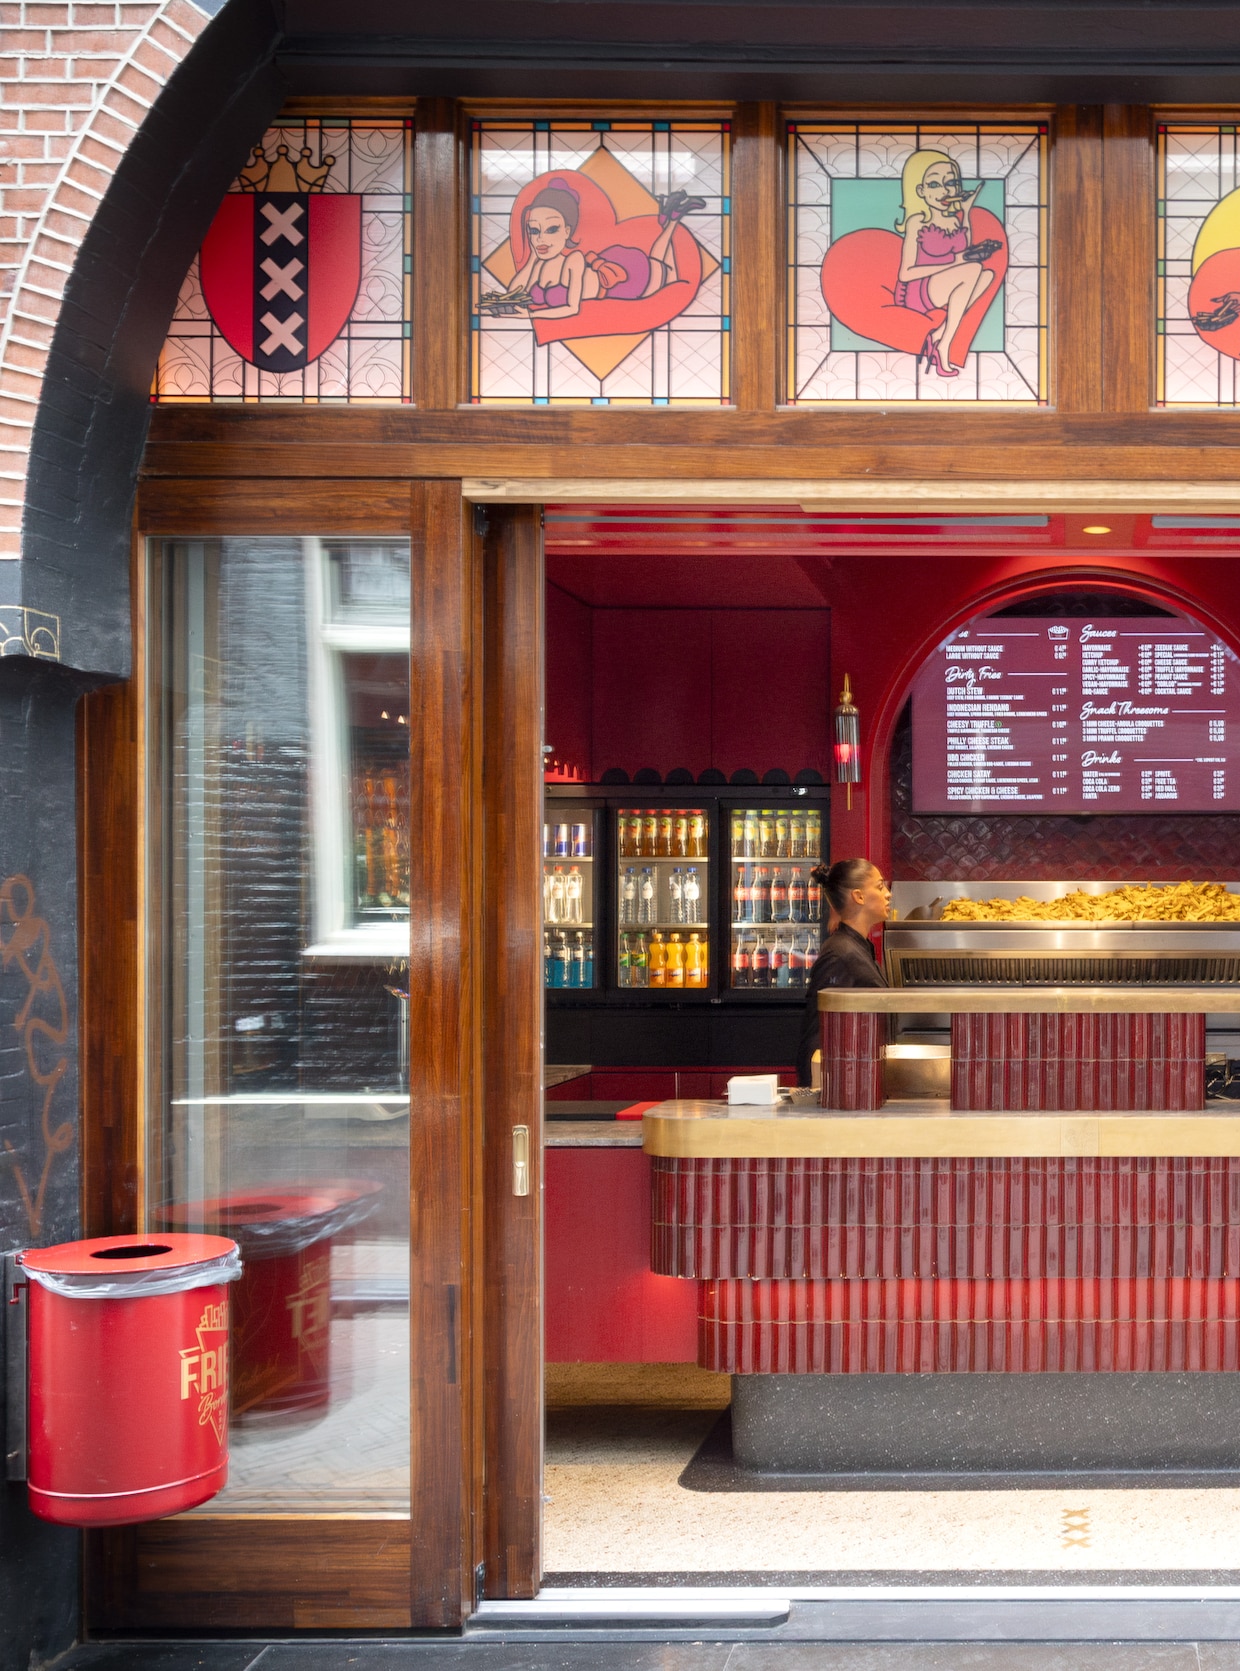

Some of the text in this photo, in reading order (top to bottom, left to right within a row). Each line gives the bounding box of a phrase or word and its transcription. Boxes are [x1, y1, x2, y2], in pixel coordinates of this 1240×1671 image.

[1079, 624, 1117, 643] Sauces
[945, 666, 1001, 688] Dirty Fries
[1080, 701, 1169, 720] Snack Threesome
[1081, 750, 1122, 767] Drinks
